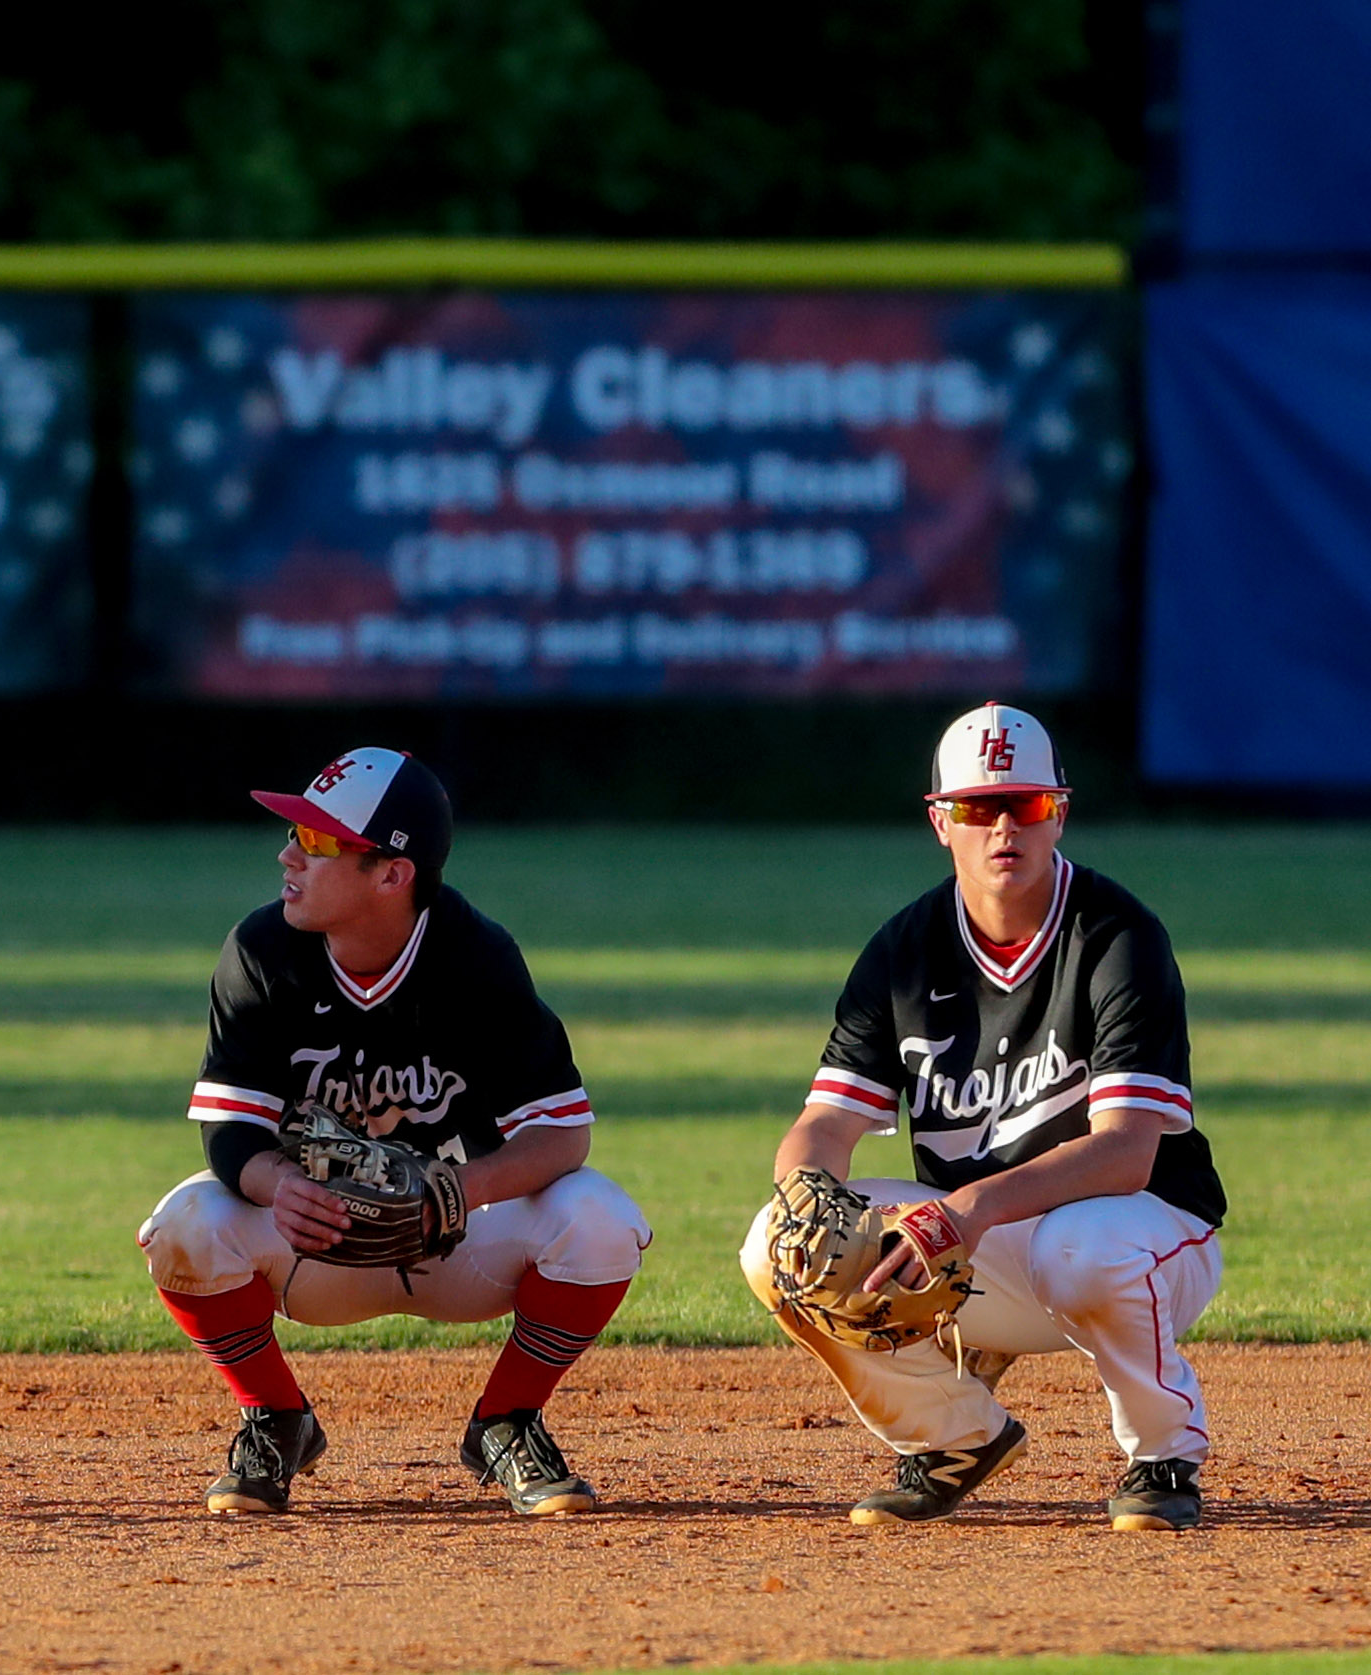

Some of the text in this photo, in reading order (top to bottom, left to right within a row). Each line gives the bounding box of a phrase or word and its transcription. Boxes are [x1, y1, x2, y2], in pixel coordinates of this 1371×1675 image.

[270, 346, 988, 442] Valley Cleaners
[748, 452, 904, 509] Road
[978, 726, 1016, 772] HG
[290, 1044, 446, 1116] Trjans
